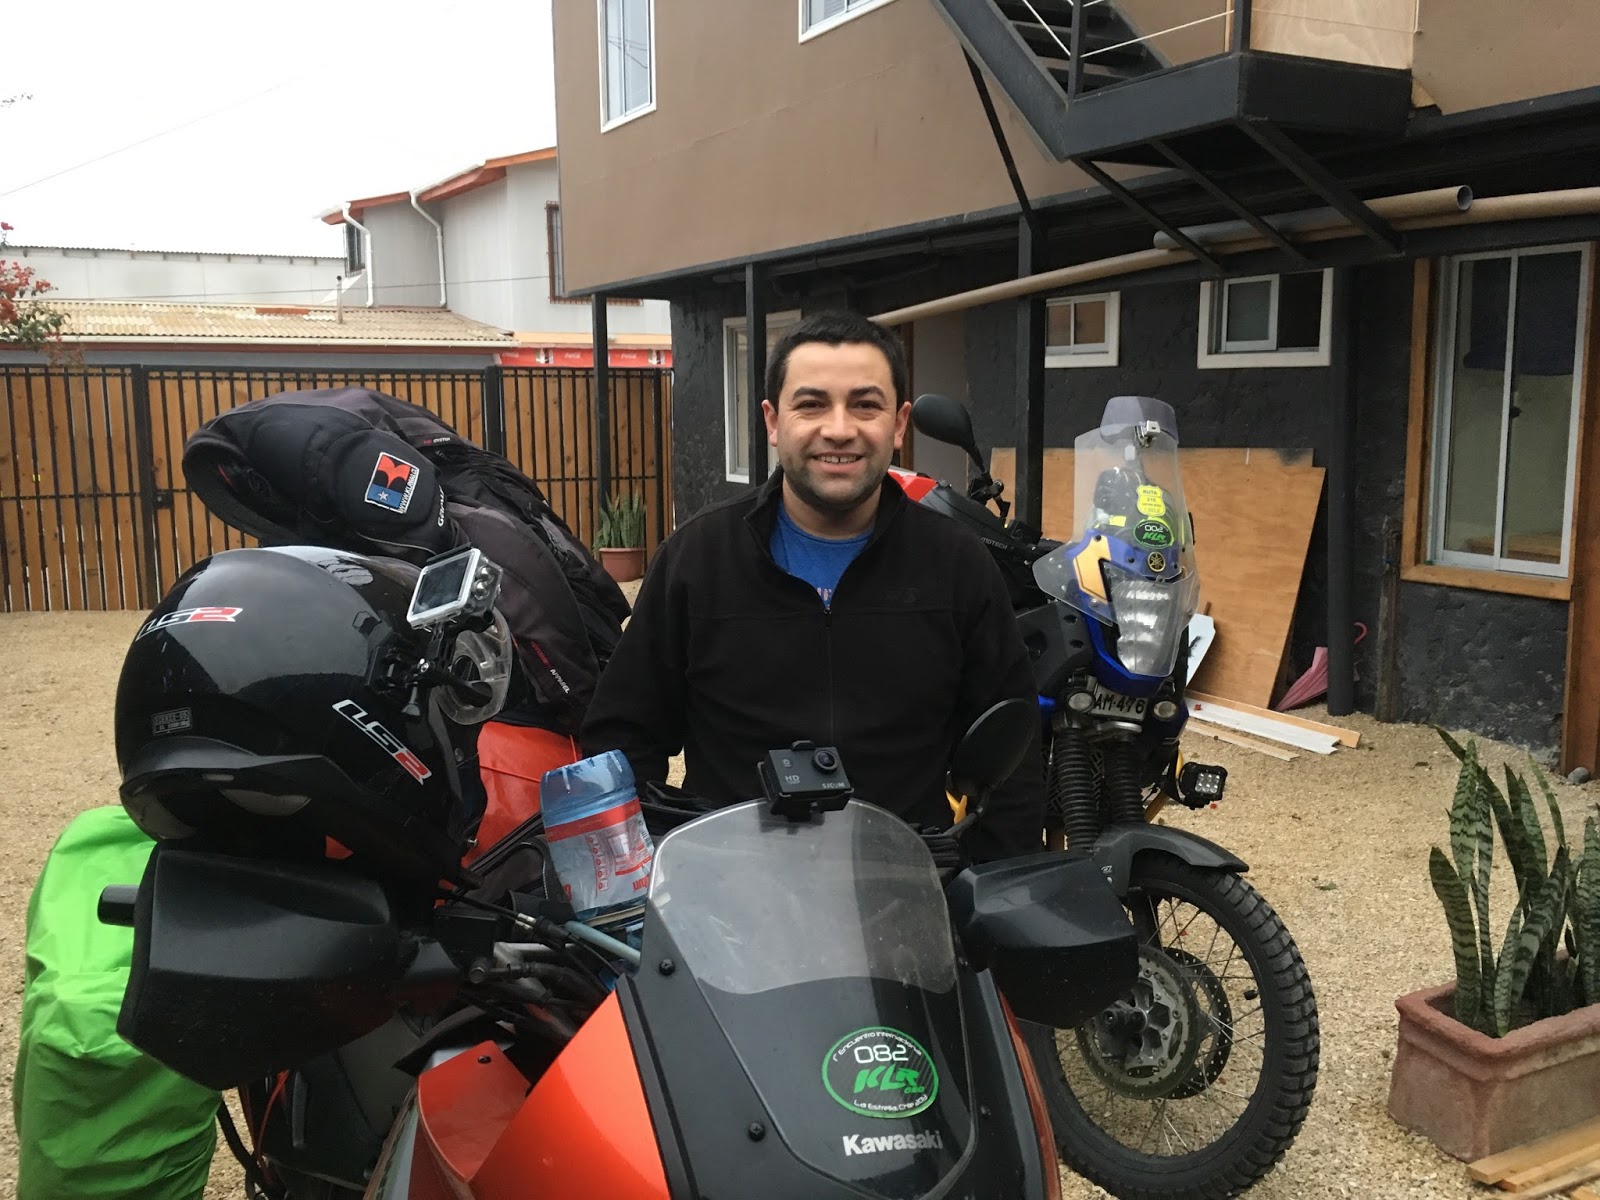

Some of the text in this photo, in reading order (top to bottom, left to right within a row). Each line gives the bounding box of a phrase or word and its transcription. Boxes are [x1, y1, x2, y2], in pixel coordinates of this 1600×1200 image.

[331, 699, 433, 785] LS2
[853, 1044, 909, 1064] 082
[853, 1063, 920, 1094] KLR
[842, 1129, 943, 1157] Kawasaki
